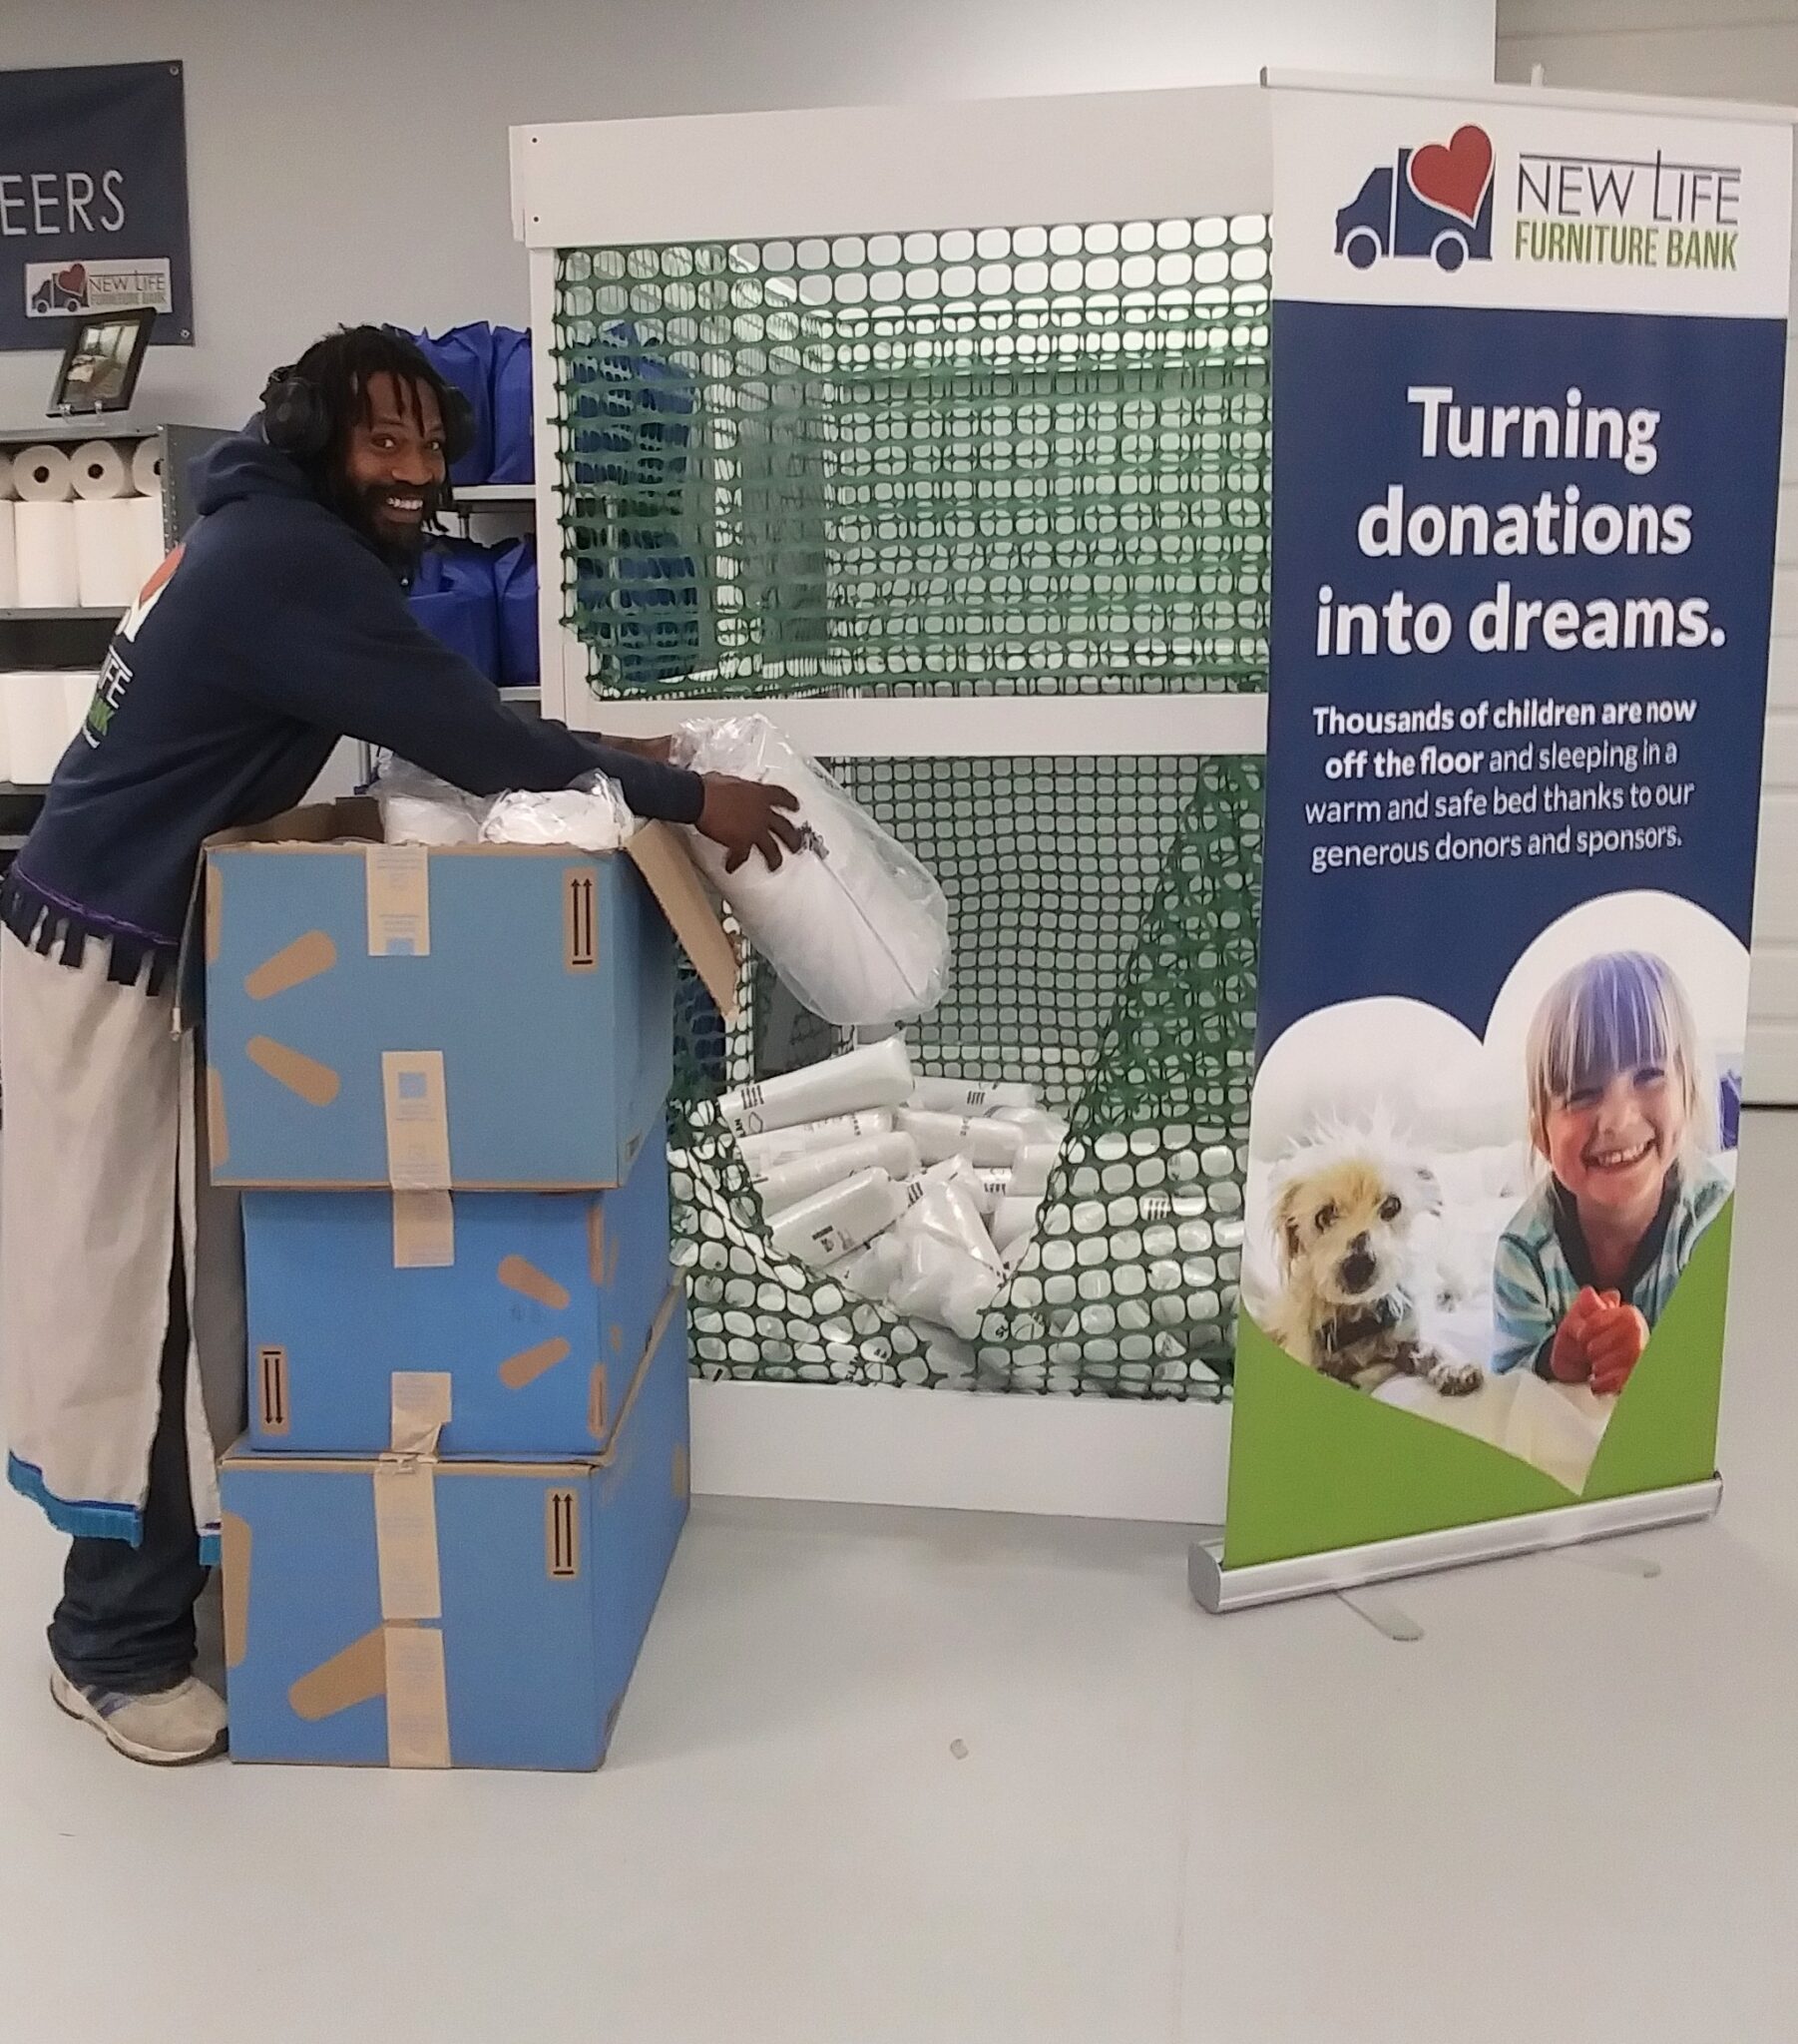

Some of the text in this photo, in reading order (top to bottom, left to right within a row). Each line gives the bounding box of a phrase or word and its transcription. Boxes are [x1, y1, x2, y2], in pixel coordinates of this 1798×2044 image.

[0, 170, 125, 236] EERS
[1517, 149, 1741, 226] NEW LIFE
[1515, 221, 1739, 271] FURNITURE BANK
[89, 269, 166, 292] NEW LIFE
[1407, 385, 1661, 476] Turning
[1357, 483, 1694, 558] donations
[1316, 581, 1727, 657] into dreams.
[1312, 698, 1697, 736] Thousands of children are now
[1325, 737, 1678, 779] off the floor and sleeping in a
[1305, 780, 1695, 825] warm and safe bed thanks to our
[1310, 823, 1683, 874] generous donors and sponsors.
